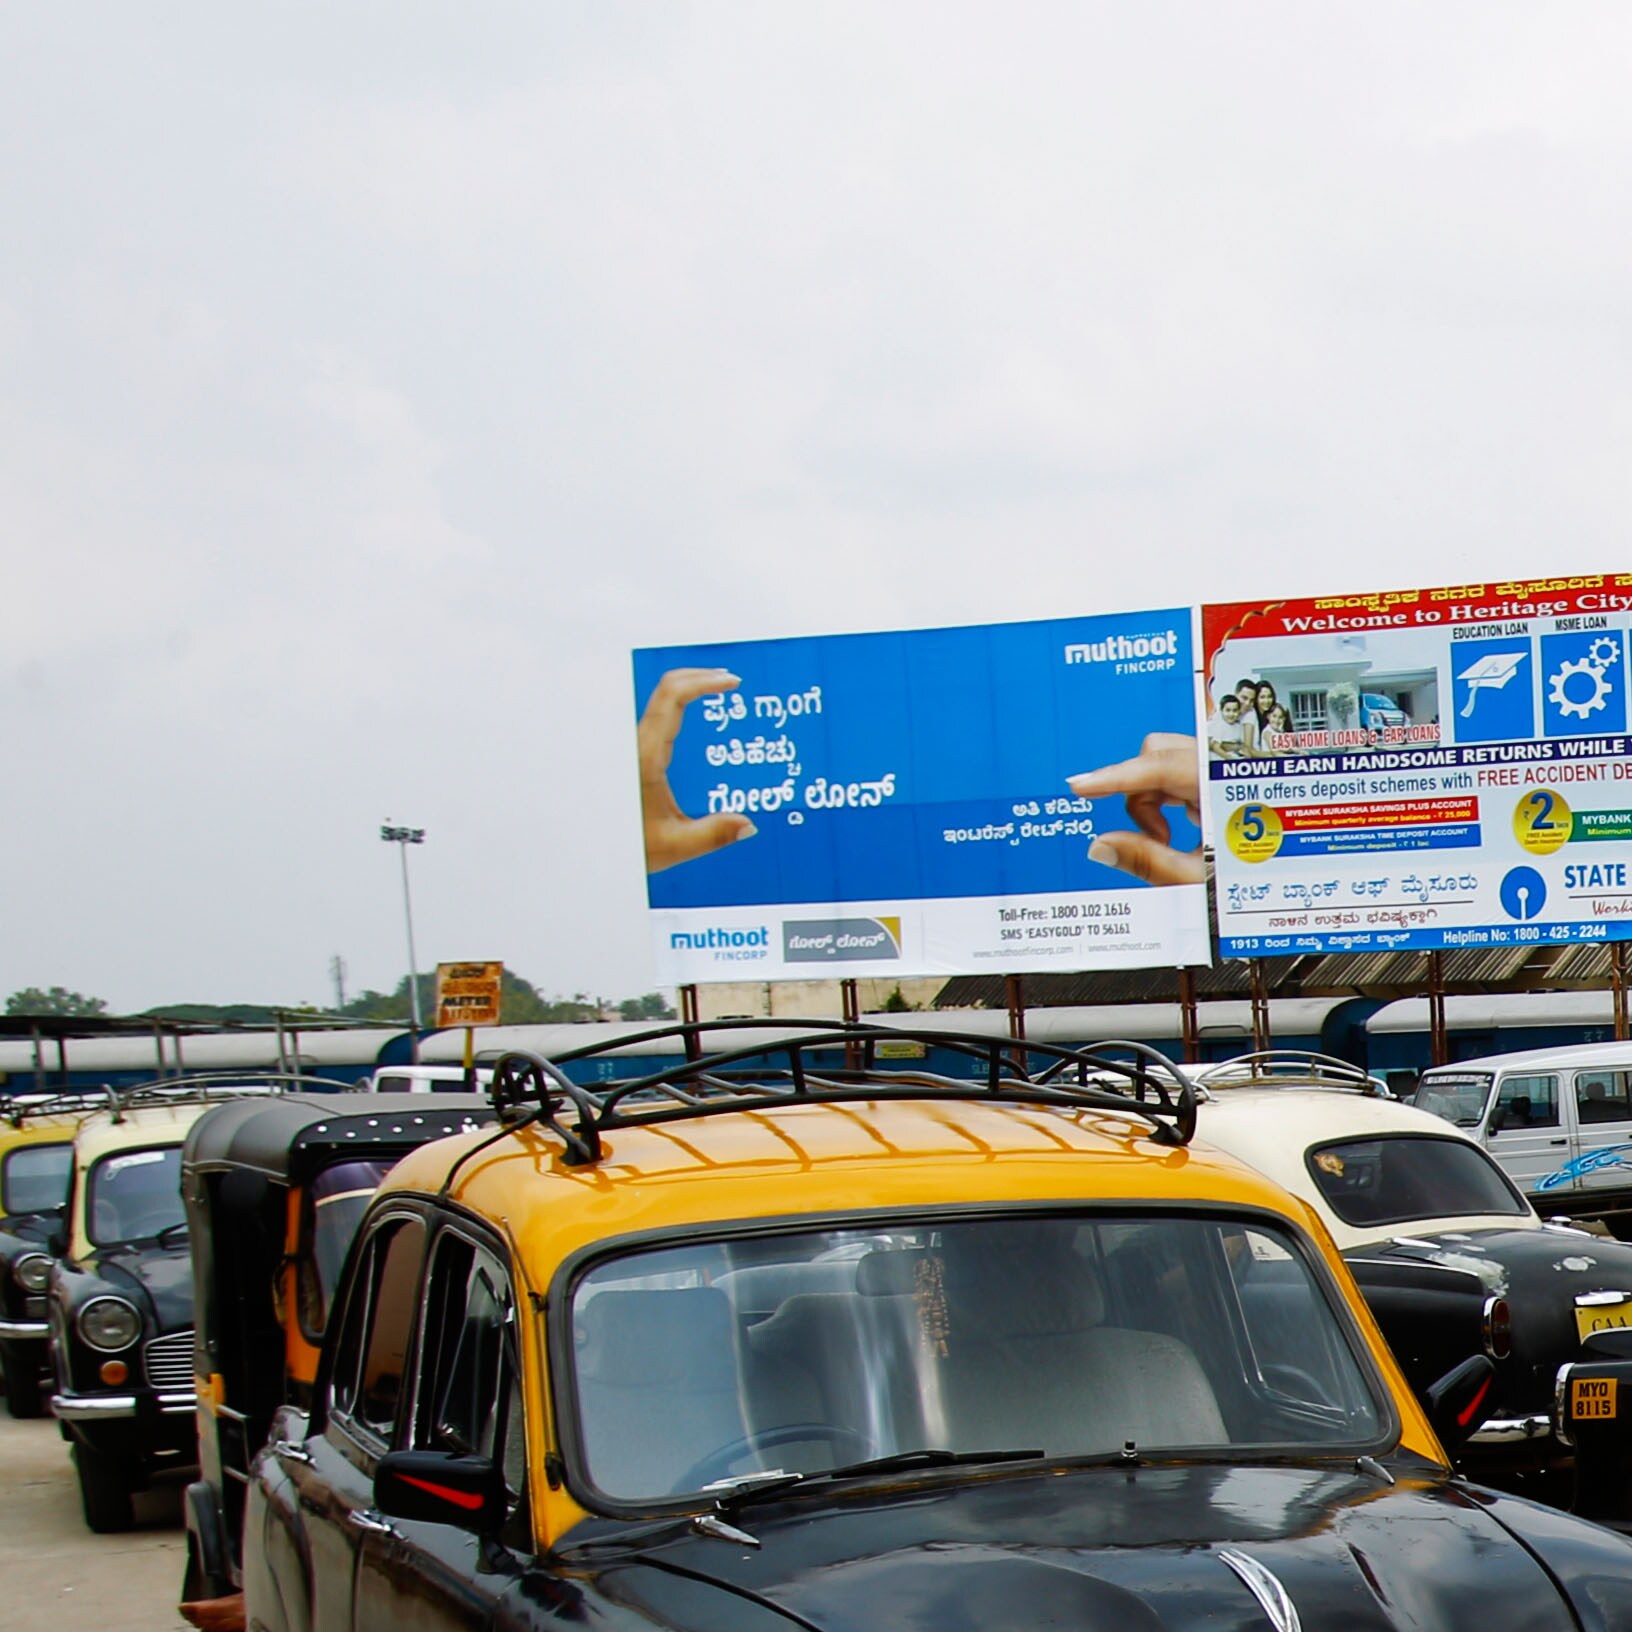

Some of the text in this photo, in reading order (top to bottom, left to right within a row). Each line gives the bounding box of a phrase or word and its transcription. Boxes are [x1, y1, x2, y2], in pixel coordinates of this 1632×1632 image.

[1281, 613, 1407, 632] Welcome
[1415, 609, 1441, 623] to
[1450, 600, 1569, 620] Heritage
[1576, 592, 1632, 611] City
[1555, 614, 1608, 630] MSME LOAN
[1452, 622, 1529, 639] EDUCATION LOAN
[1064, 630, 1178, 664] muthoot
[1116, 658, 1176, 675] FINCORP
[703, 692, 747, 732] ಪ್ರತಿ
[1271, 725, 1441, 749] EASY HOME LOANS CAR LOANS
[1223, 760, 1277, 777] NOW!
[1283, 757, 1337, 774] EARN
[1342, 750, 1457, 771] HANDSOME
[1463, 744, 1552, 763] RETURNS
[1558, 738, 1625, 758] WHILE
[805, 773, 896, 809] ಲೋನ್
[1226, 783, 1259, 801] SBM
[1264, 779, 1306, 799] offers
[1311, 776, 1366, 798] deposit
[1371, 774, 1436, 795] schemes
[1441, 772, 1473, 789] with
[1478, 768, 1519, 787] FREE
[1524, 763, 1608, 784] ACCIDENT
[1431, 800, 1473, 810] ACCOUNT
[1530, 792, 1556, 830] 2
[1582, 814, 1632, 825] MYBANK
[1587, 826, 1632, 836] Minimum
[1564, 861, 1627, 889] STATE
[1283, 874, 1478, 907] ಬ್ಯಾಂಕ್ ಮೈಸೂರು
[998, 902, 1131, 922] Toll-Free: 1800 102 1616
[670, 926, 769, 949] muthoot
[1001, 922, 1130, 940] SMS TO 56161
[1443, 924, 1608, 945] Helpline No: 1800 425 2244
[1088, 941, 1161, 953] www.muthoot.com
[1230, 939, 1259, 949] 1913
[714, 950, 768, 961] FINCORP
[1579, 1382, 1608, 1398] MYO
[1576, 1401, 1611, 1416] 8115
